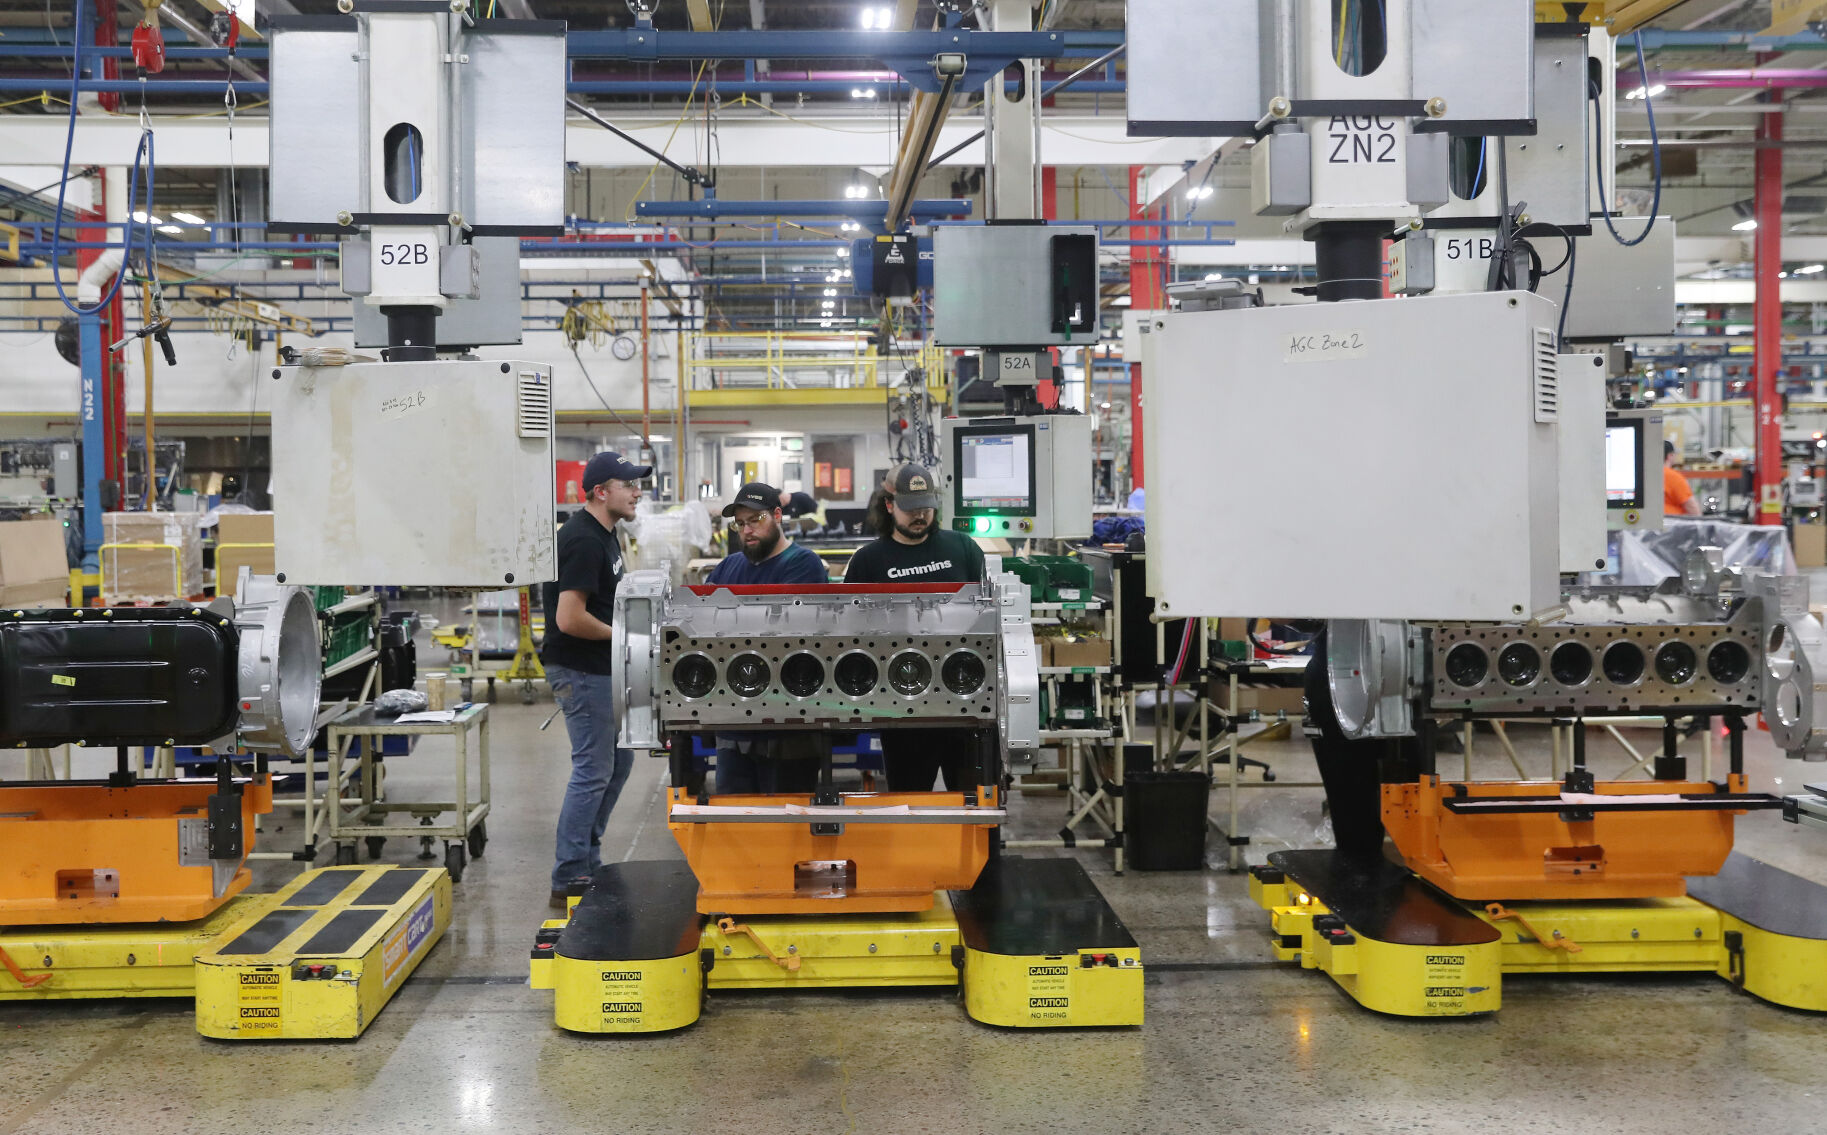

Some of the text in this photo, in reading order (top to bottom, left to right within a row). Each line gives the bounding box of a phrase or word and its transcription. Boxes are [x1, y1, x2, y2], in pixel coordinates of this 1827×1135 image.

[1329, 133, 1396, 163] ZN2
[1447, 238, 1493, 260] 51B
[381, 243, 429, 265] 52B
[1290, 333, 1364, 355] AGC Zone 2
[1004, 357, 1031, 370] 52A
[887, 559, 953, 579] Cummins
[1426, 956, 1464, 965] CAUTION
[1029, 967, 1068, 975] CAUTION
[241, 974, 279, 984] CAUTION
[602, 972, 641, 981] CAUTION
[1426, 988, 1464, 997] CAUTION
[1030, 998, 1068, 1007] CAUTION
[603, 1003, 641, 1012] CAUTION
[241, 1008, 279, 1017] CAUTION
